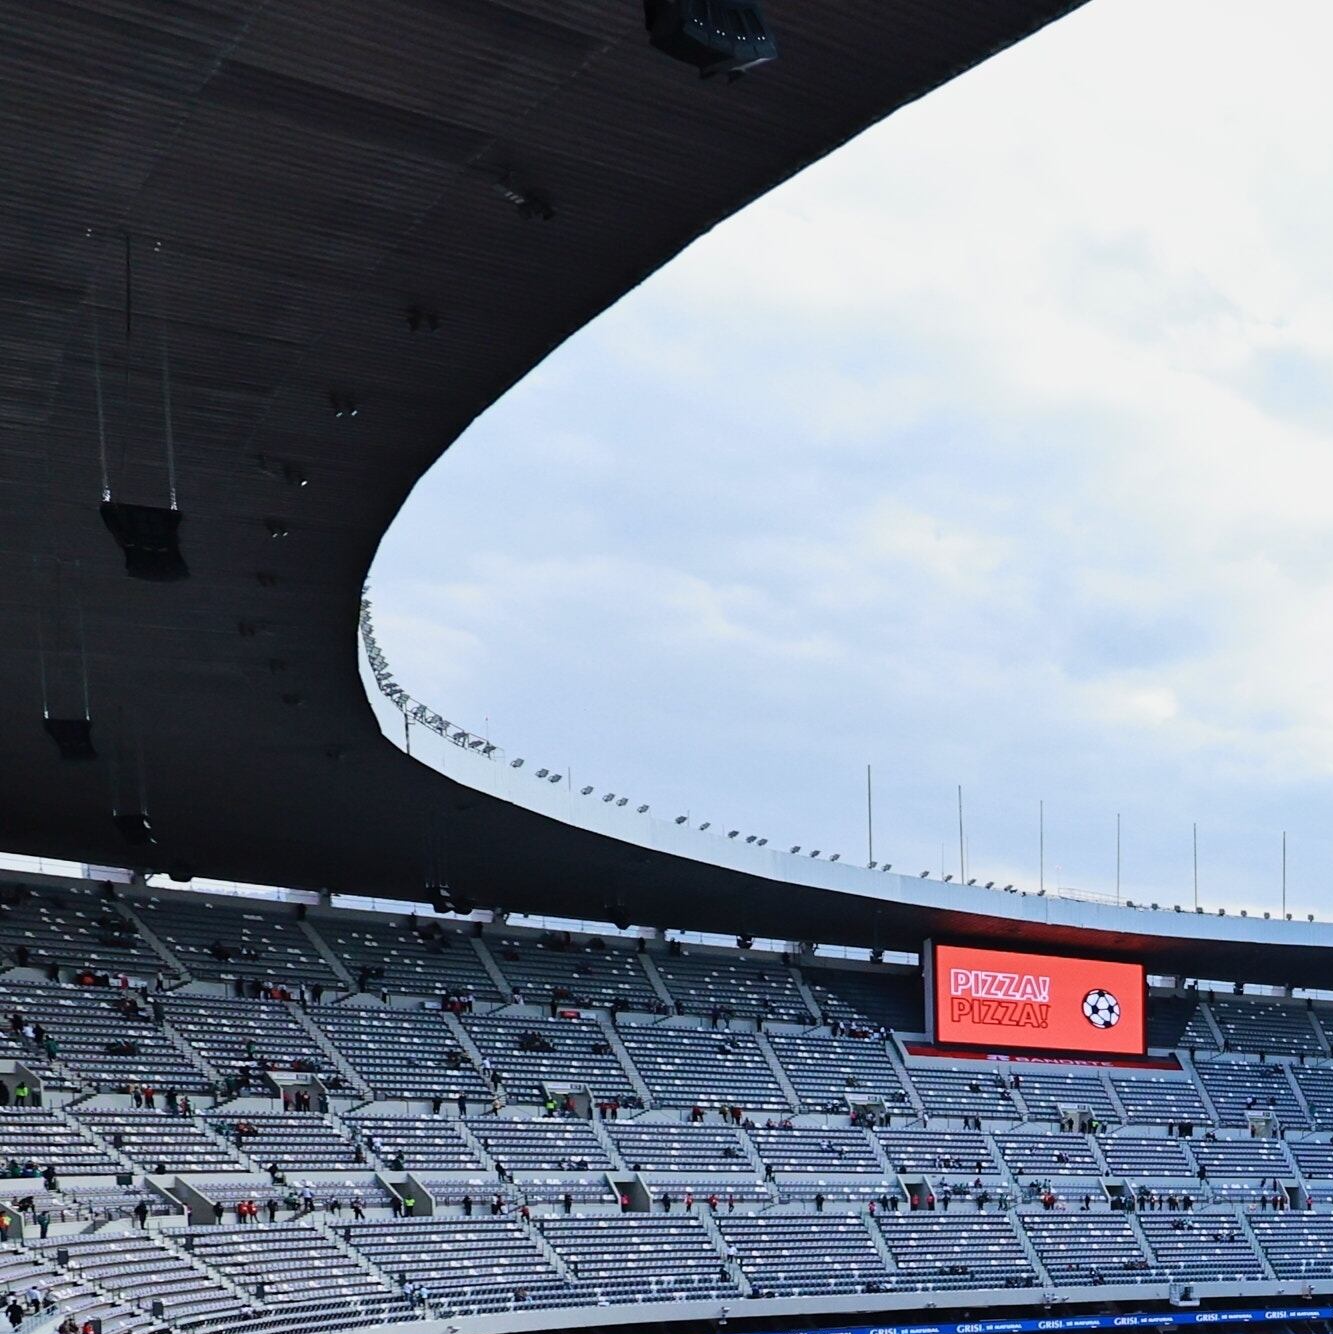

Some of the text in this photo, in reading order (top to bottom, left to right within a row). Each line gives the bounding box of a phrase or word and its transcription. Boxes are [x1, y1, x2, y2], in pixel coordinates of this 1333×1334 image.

[950, 968, 1050, 1003] PIZZA!
[951, 997, 1051, 1029] PIZZA!
[1038, 1320, 1063, 1329] GRISI
[1113, 1317, 1138, 1326] GRISI
[956, 1324, 982, 1333] GRISI
